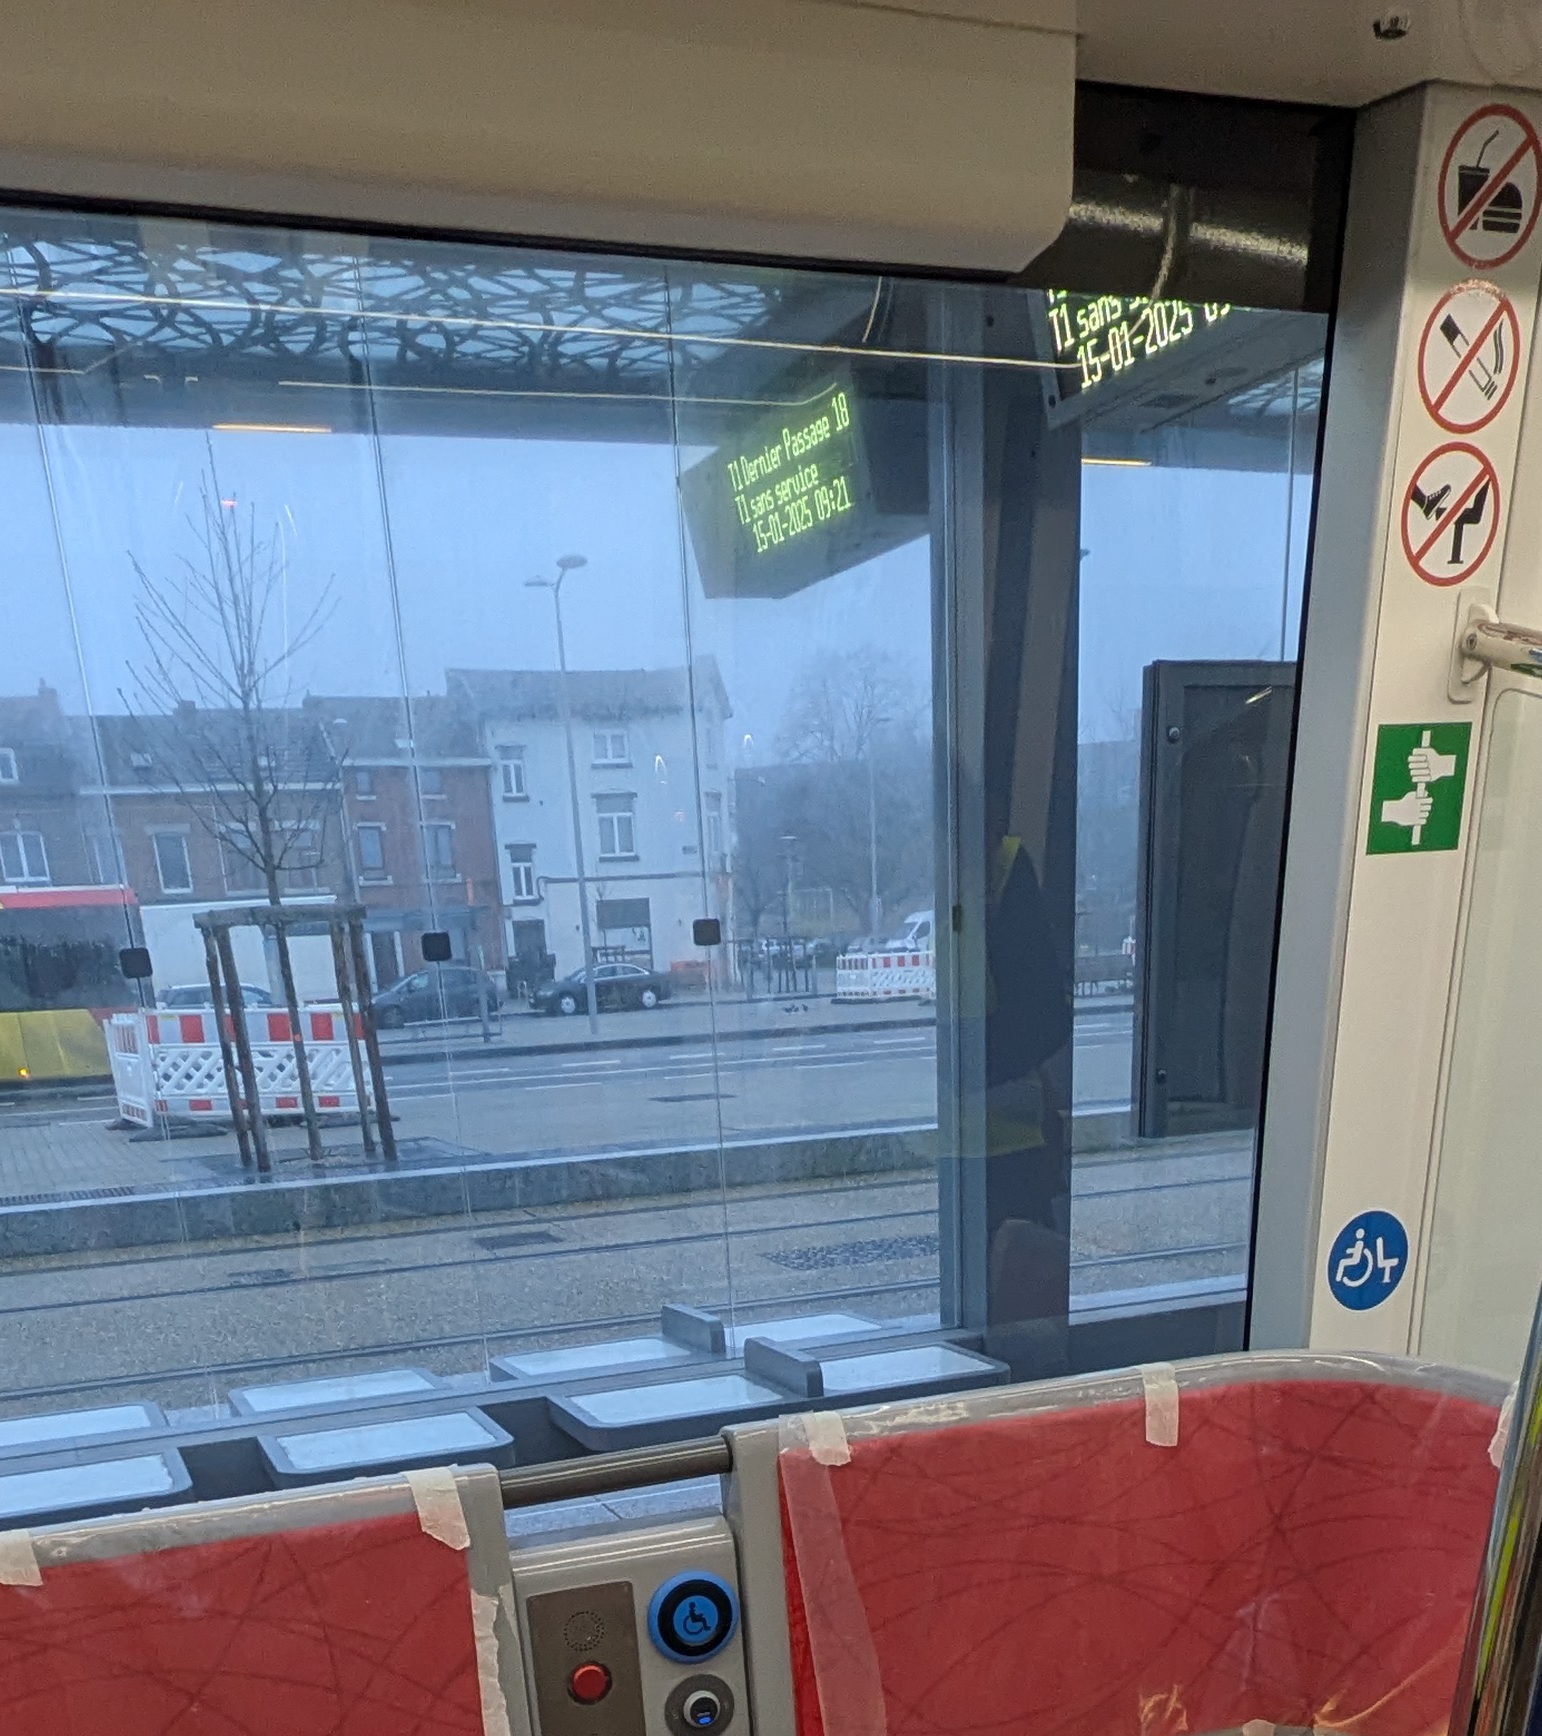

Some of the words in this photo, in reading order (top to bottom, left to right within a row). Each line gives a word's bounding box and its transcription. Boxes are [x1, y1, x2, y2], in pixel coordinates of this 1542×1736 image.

[1049, 304, 1075, 351] T1
[1076, 295, 1122, 339] sans
[1076, 300, 1194, 389] 15-01-2025
[741, 446, 781, 486] Dernier
[782, 415, 830, 460] Passage
[831, 392, 850, 432] 18
[734, 494, 751, 525] T1
[750, 489, 775, 518] sans
[775, 463, 819, 504] service
[752, 495, 814, 553] 15-01-2025
[814, 475, 853, 521] 09:21
